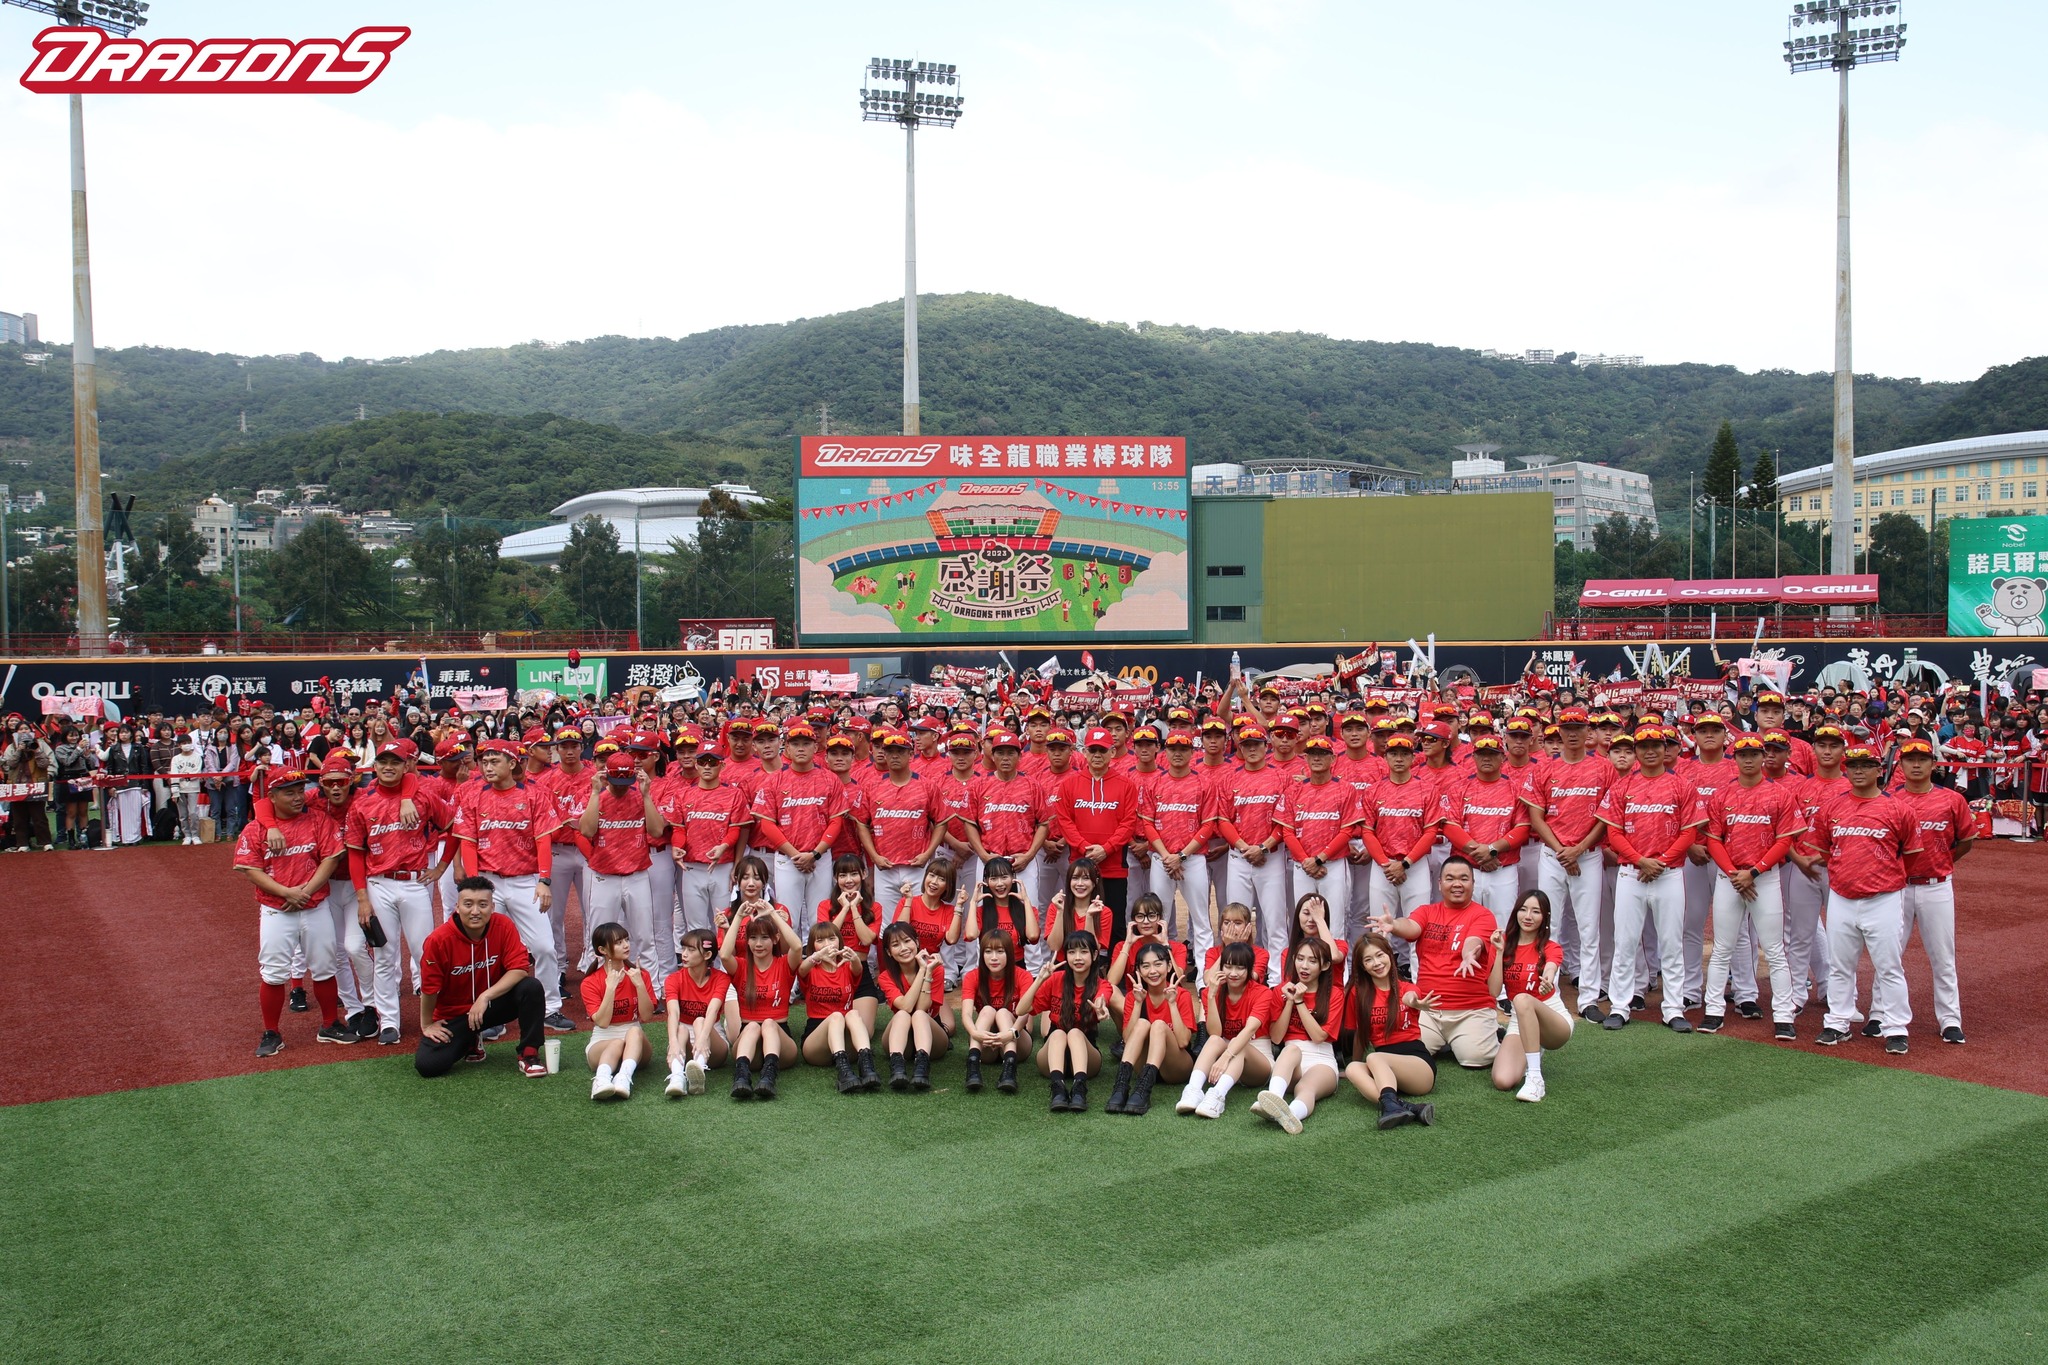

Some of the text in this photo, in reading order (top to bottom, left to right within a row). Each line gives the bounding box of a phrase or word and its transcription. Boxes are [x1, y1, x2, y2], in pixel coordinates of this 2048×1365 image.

[814, 443, 942, 467] DRAGONS
[949, 444, 1173, 468] 味全龍職業棒球隊
[957, 482, 1028, 496] DRAGONS
[1151, 481, 1180, 491] 13:55
[1967, 552, 2036, 575] 諾貝爾
[940, 554, 1052, 601] 感謝祭
[1583, 588, 1668, 598] O-GRILL
[1680, 587, 1769, 596] O-GRILL
[1783, 585, 1877, 594] O-GRILL
[953, 605, 1036, 619] DRAGONS FAN FEST
[1117, 665, 1159, 686] 400
[31, 681, 131, 701] O-GRILL
[170, 682, 203, 696] 大葉
[1551, 786, 1601, 798] DRAGONS
[782, 796, 827, 808] DRAGONS
[983, 802, 1031, 814] DRAGONS
[1074, 799, 1119, 810] DRAGONS
[1625, 802, 1678, 814] DRAGONS
[874, 808, 924, 819] DRAGONS
[1463, 804, 1514, 816] DRAGONS
[479, 819, 531, 831] DRAGONS
[598, 817, 646, 829] DRAGONS
[911, 825, 925, 840] 66
[1832, 825, 1890, 839] DRAGONS
